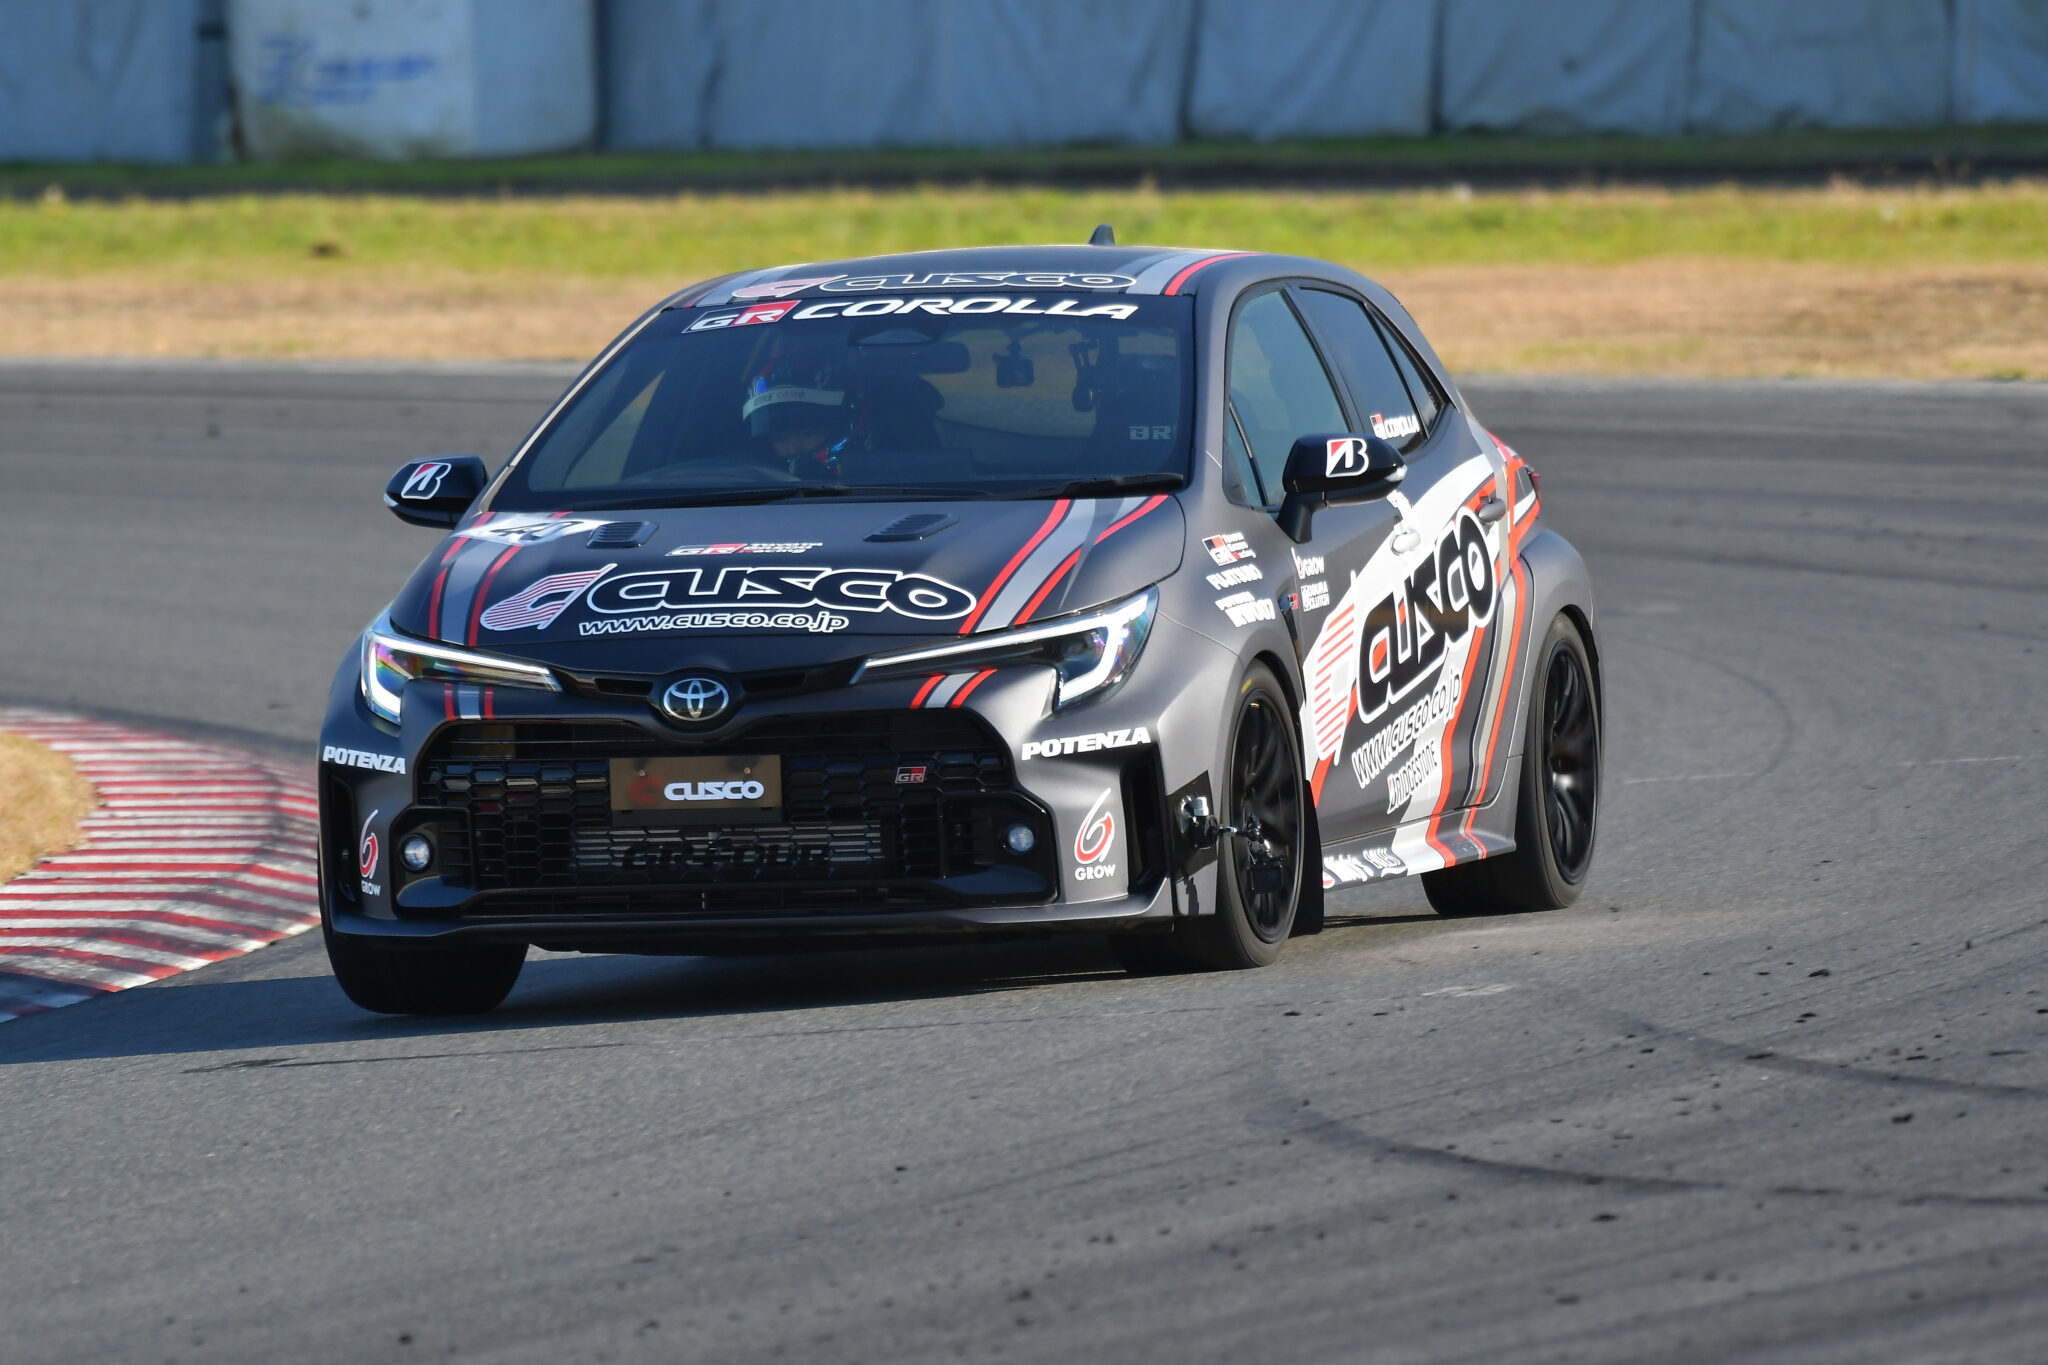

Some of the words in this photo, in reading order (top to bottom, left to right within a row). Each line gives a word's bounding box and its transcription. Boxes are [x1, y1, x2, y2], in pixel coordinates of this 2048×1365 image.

[686, 305, 793, 332] GR
[792, 297, 1140, 321] COROLLA
[668, 545, 742, 556] GR
[578, 610, 850, 637] www.cusco.co.jp
[1351, 667, 1463, 790] www.cusco.co.jp
[1021, 726, 1152, 761] POTENZA
[322, 745, 407, 775] POTENZA
[897, 770, 925, 783] GR
[1386, 736, 1440, 815] BRIDGESTONE
[663, 780, 765, 801] CUSCO
[1074, 863, 1117, 881] GROW
[360, 880, 382, 897] GROW
